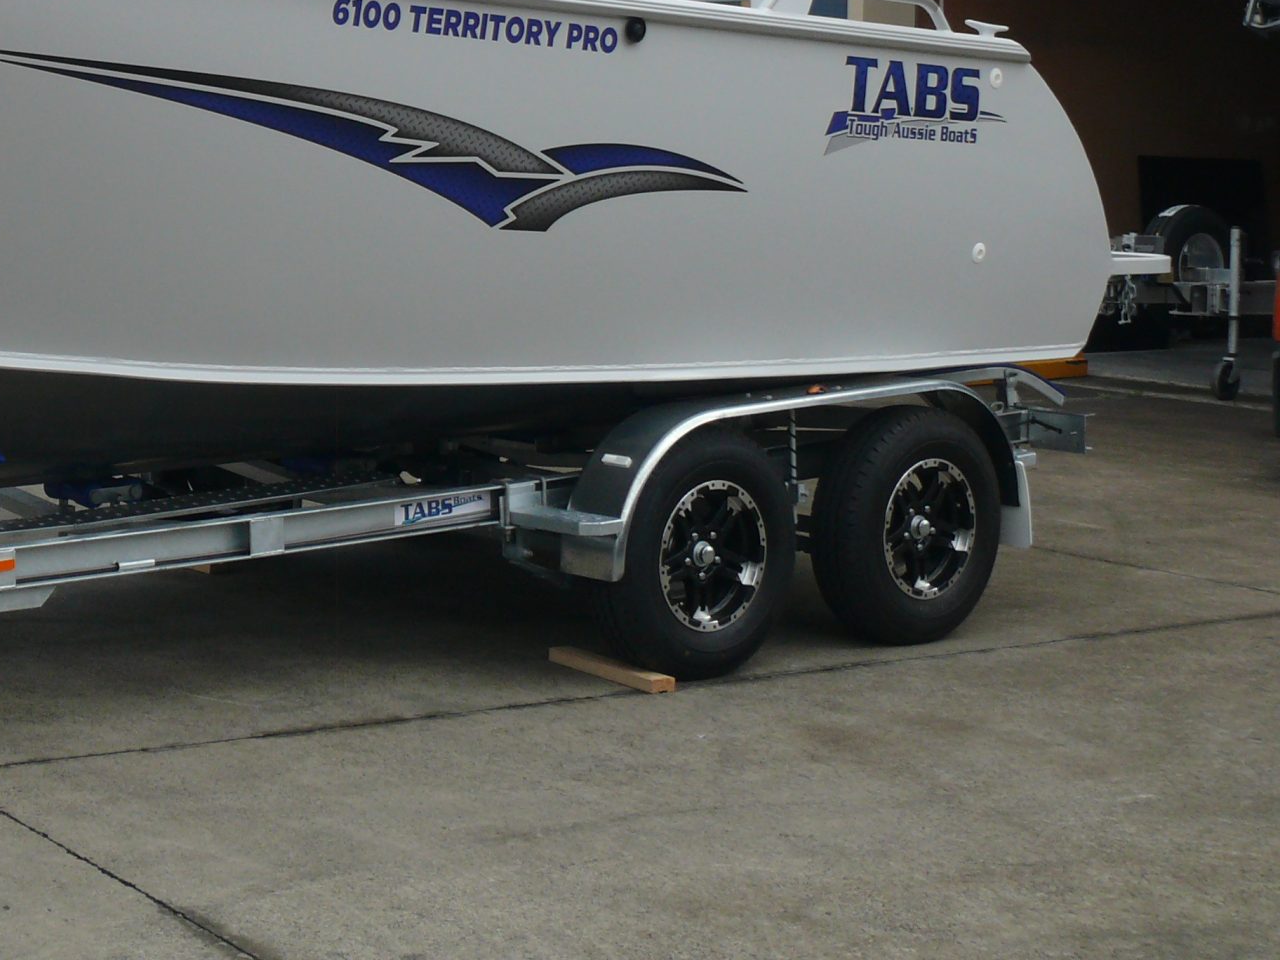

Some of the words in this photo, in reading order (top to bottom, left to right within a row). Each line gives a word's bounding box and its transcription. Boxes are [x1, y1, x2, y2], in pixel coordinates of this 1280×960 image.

[409, 5, 562, 47] TERRITORY
[566, 23, 618, 54] PRO
[846, 55, 980, 122] TABS
[848, 118, 888, 141] Tough
[893, 122, 936, 141] Aussie
[400, 497, 453, 521] TABS
